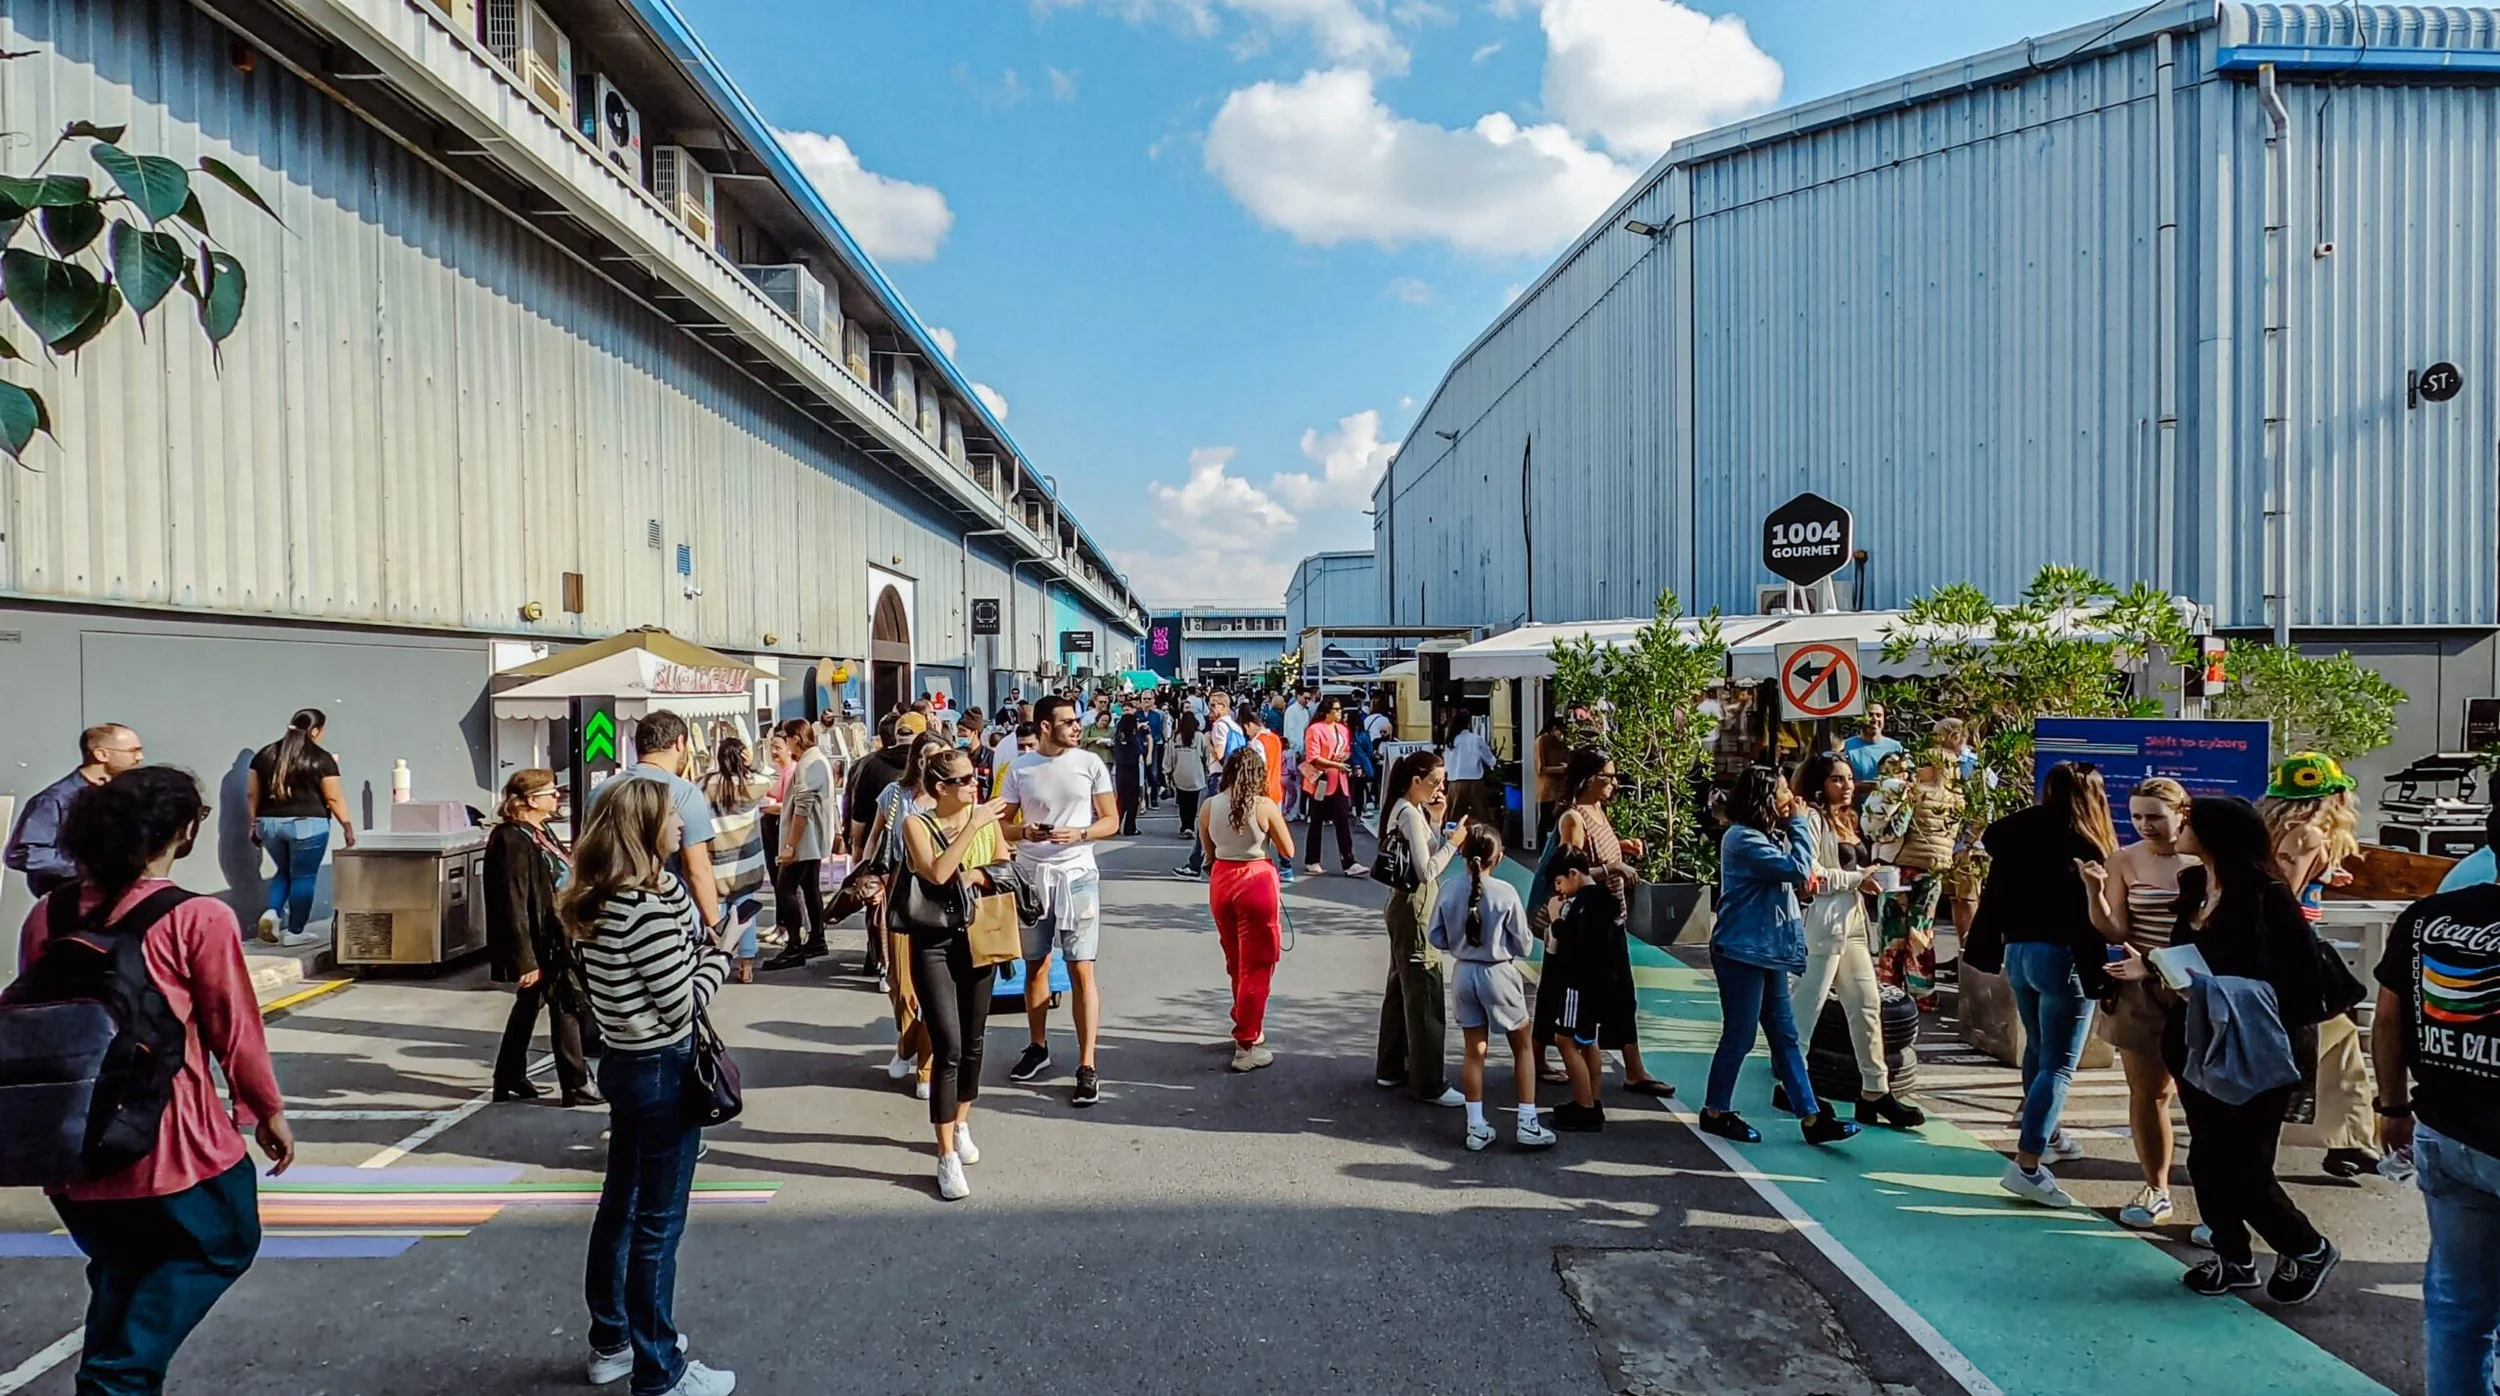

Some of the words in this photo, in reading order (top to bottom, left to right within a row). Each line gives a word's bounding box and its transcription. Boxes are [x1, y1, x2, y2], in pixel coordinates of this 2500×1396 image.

[1772, 520, 1841, 545] 1004
[1771, 544, 1841, 558] GOURMET
[2424, 1025, 2457, 1058] ICE
